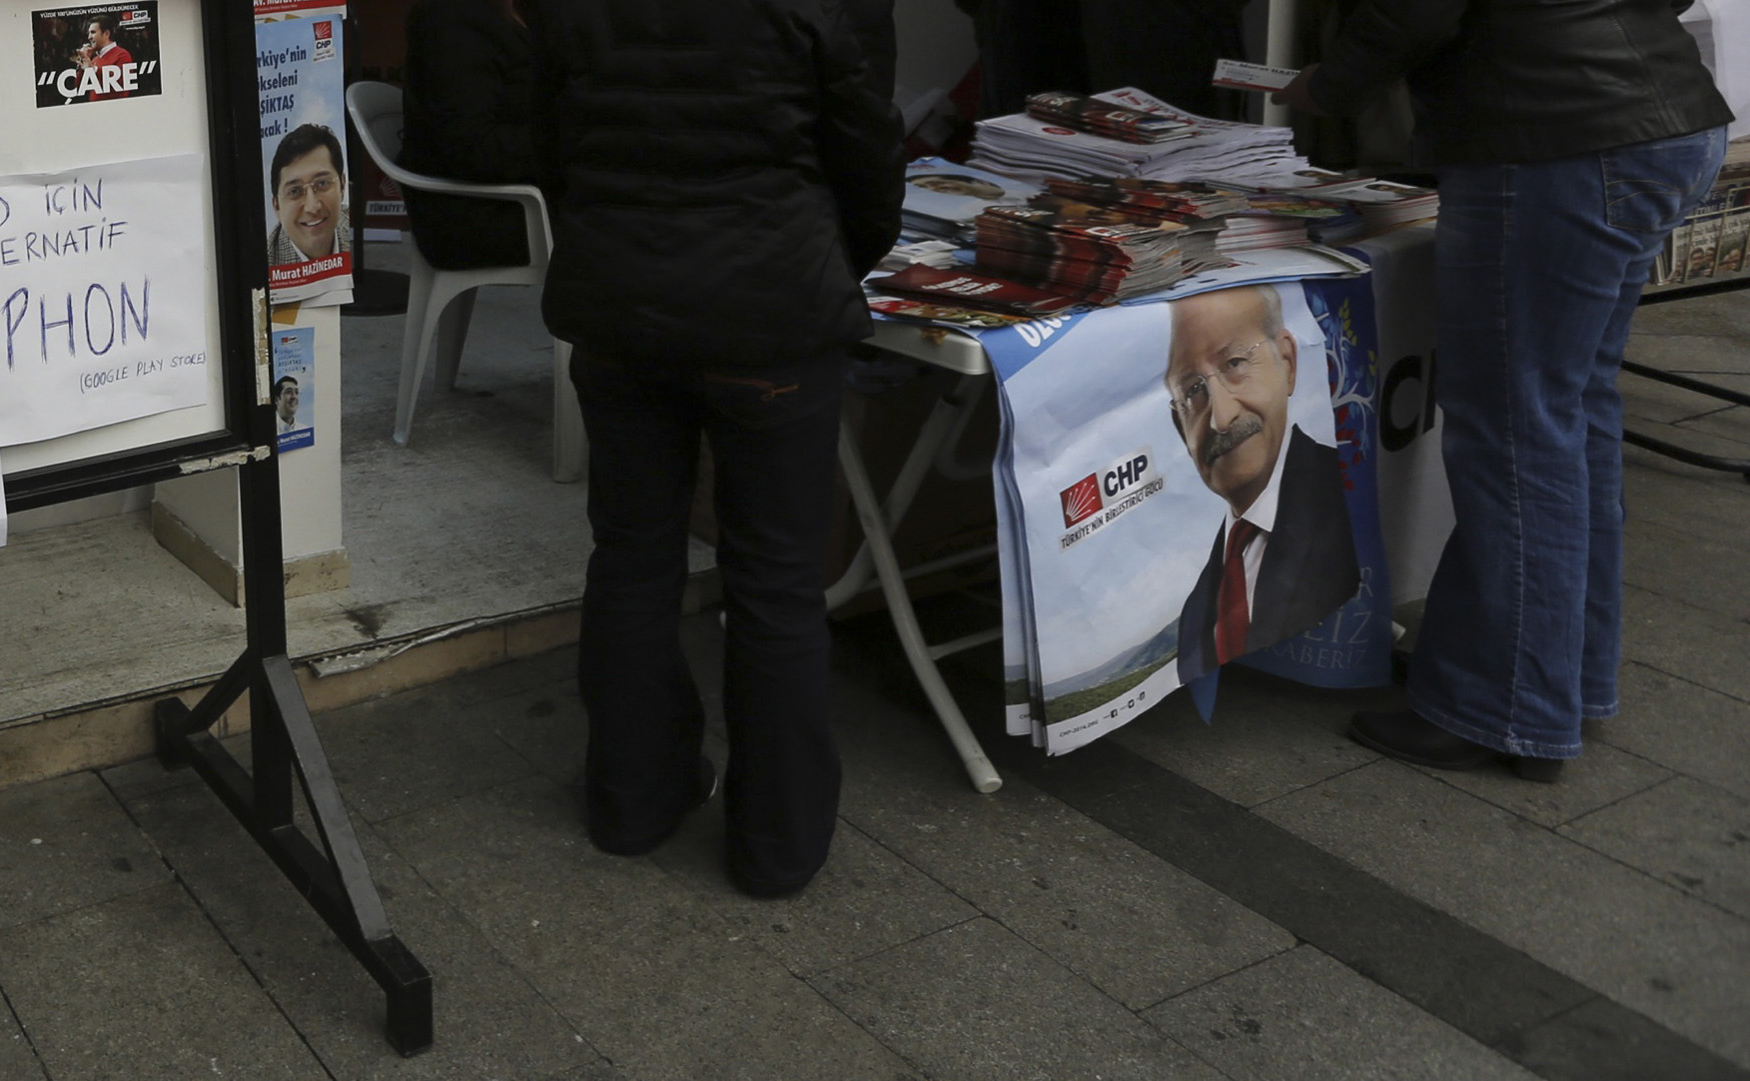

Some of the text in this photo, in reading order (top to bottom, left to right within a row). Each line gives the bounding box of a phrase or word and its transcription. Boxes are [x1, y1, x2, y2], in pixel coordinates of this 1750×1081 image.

[272, 256, 343, 281] Murat HAZİNEDAR
[136, 358, 164, 378] PLAY
[1104, 455, 1148, 497] CHP
[1061, 514, 1104, 549] TÜRKİYE'NİN
